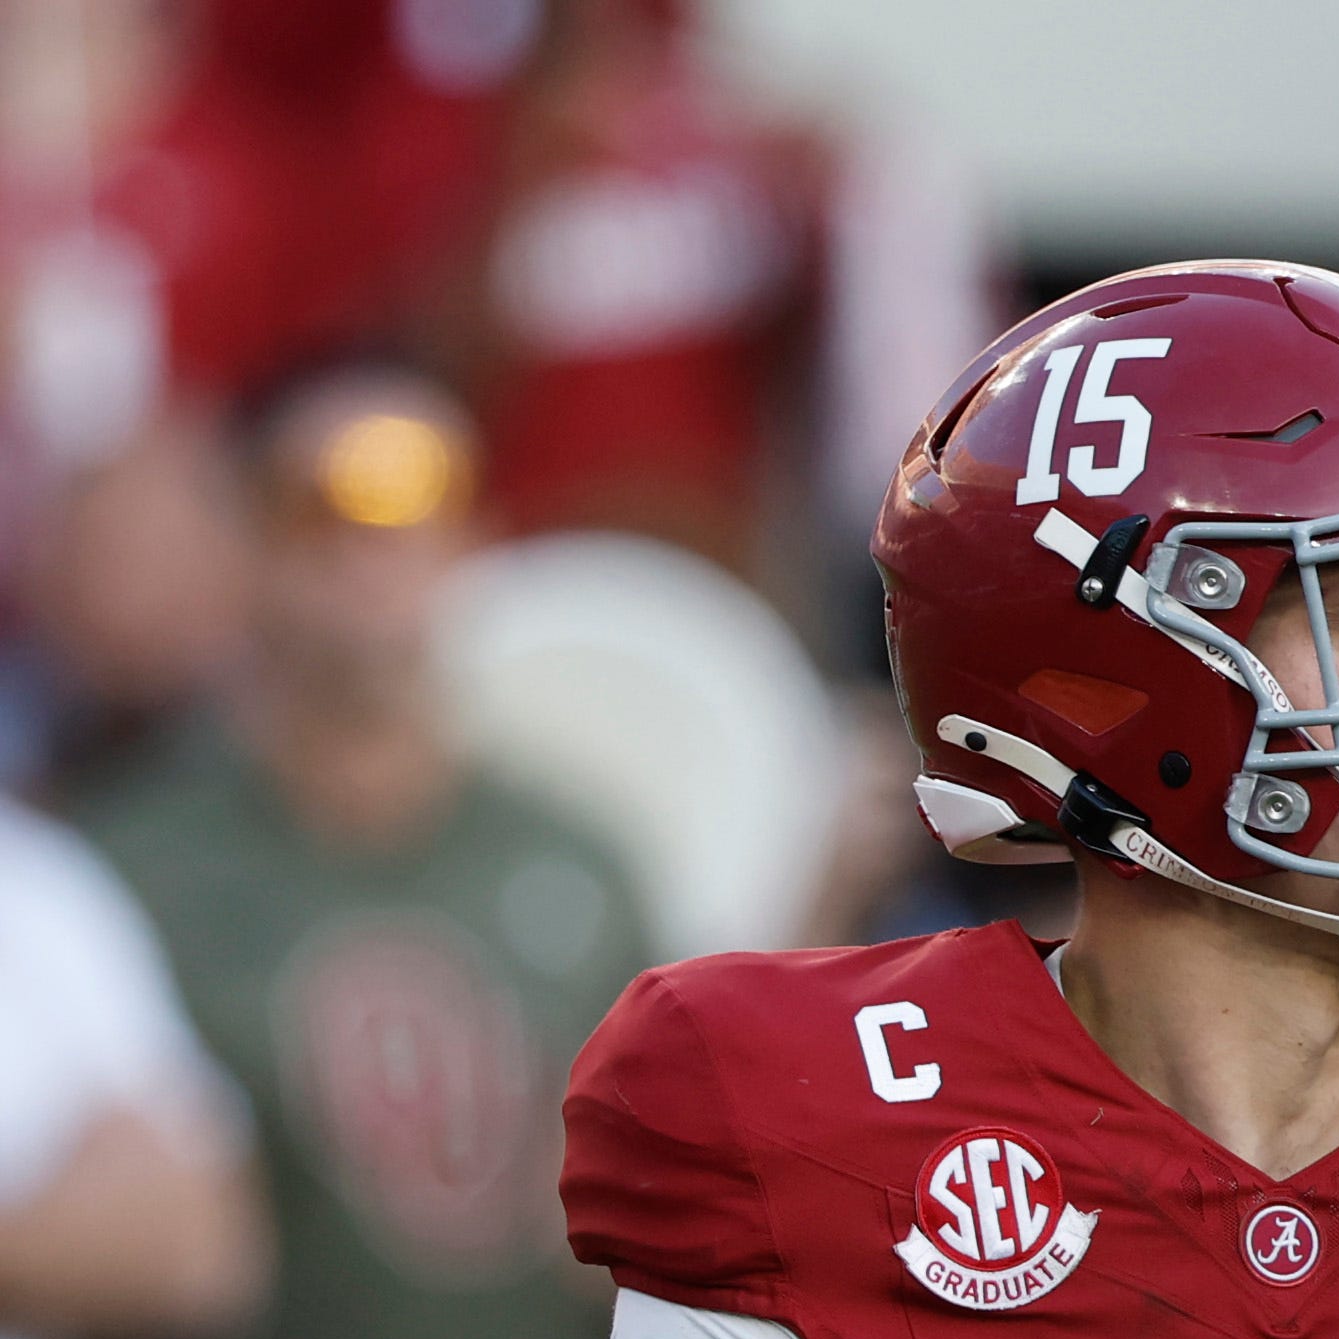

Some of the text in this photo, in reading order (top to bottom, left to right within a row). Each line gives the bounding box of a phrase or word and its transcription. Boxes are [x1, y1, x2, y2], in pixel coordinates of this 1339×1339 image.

[1015, 337, 1173, 507] 15
[853, 1000, 943, 1103] C
[928, 1137, 1050, 1261] SEC
[1257, 1216, 1304, 1265] A
[924, 1242, 1076, 1305] GRADUATE
